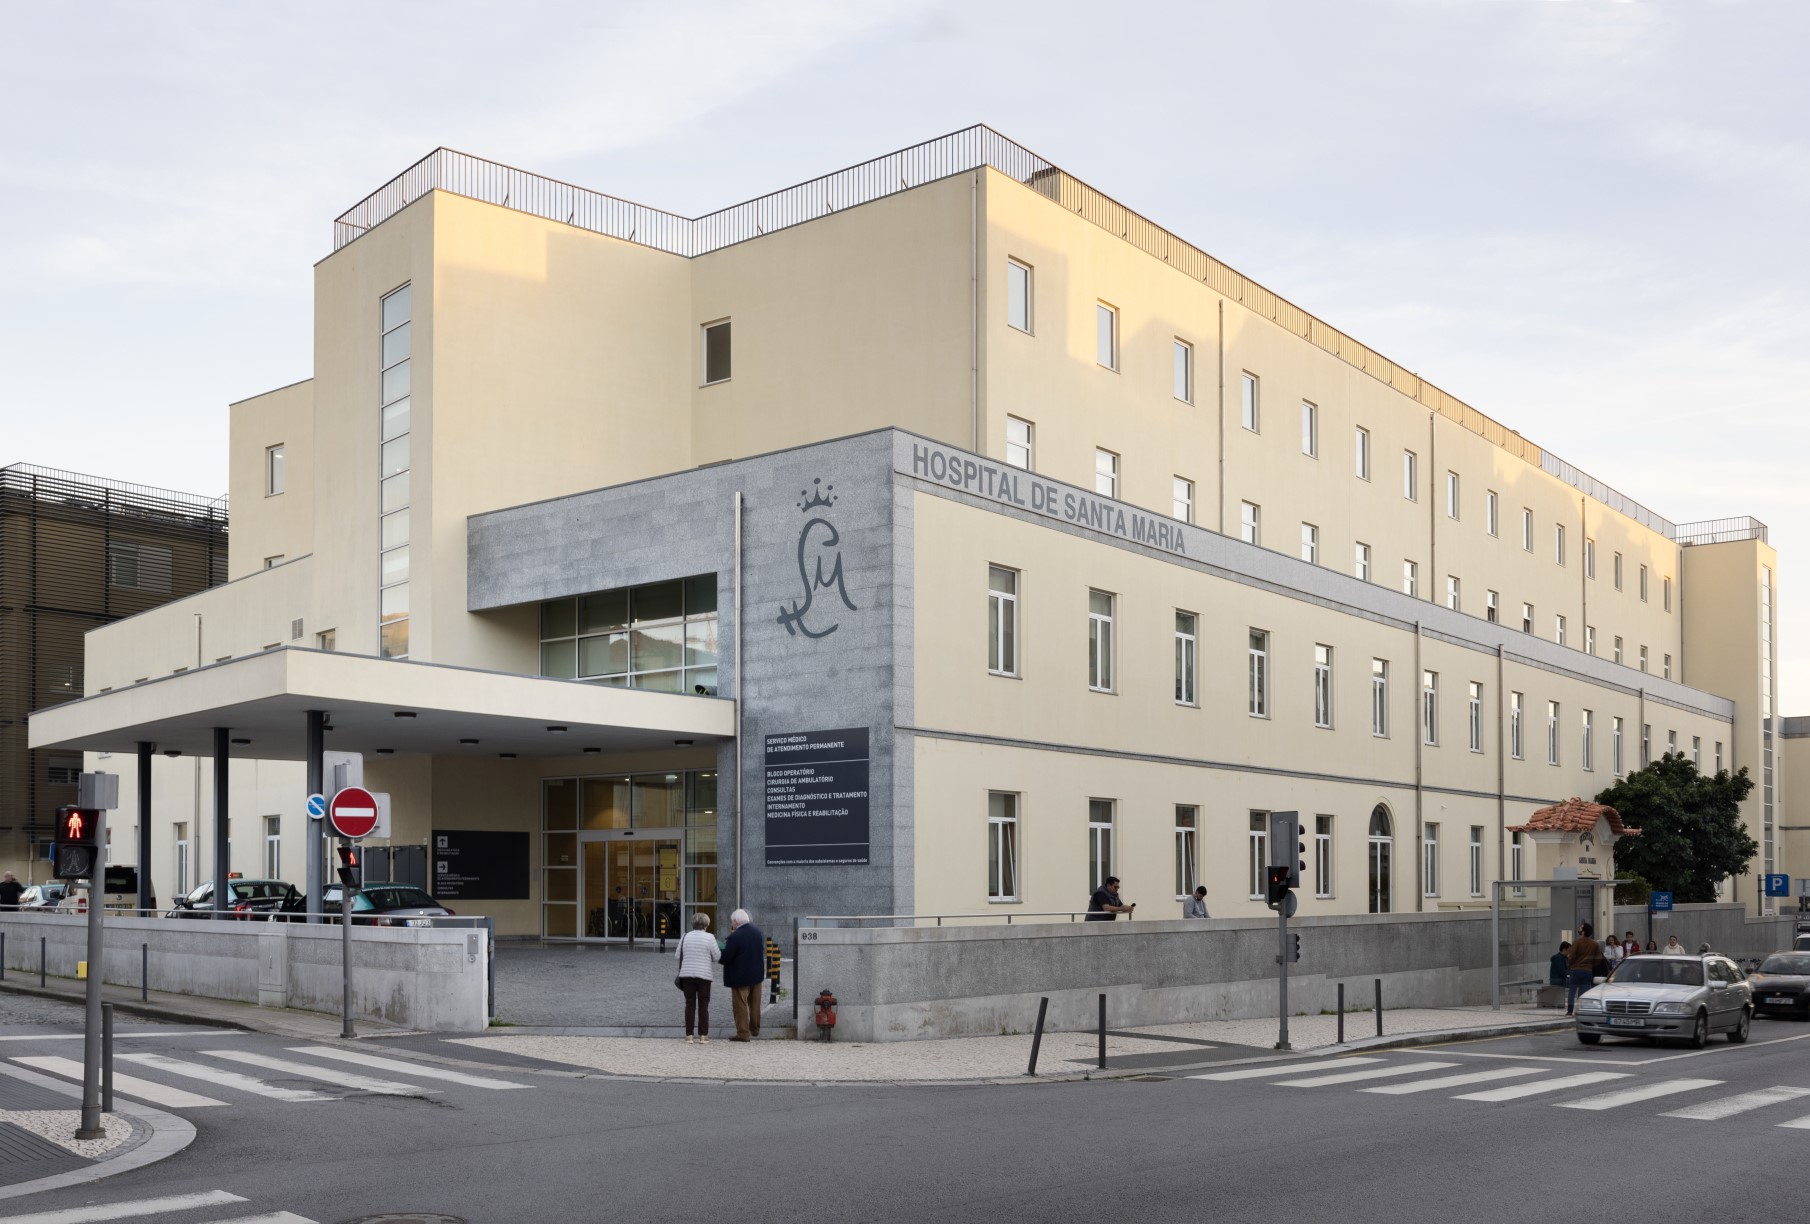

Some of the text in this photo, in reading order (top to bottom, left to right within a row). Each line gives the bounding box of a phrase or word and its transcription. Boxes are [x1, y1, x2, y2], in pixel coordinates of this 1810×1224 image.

[913, 444, 1186, 554] HOSPITAL DE SANTA MARIA
[767, 735, 807, 745] SERVIÇO MÉDICO
[774, 744, 809, 752] ATENDIMENTO
[810, 741, 845, 750] PERMANENTE
[767, 768, 815, 778] BLOCO OPERATÓRIO
[767, 778, 790, 786] CIRURGIA
[798, 775, 834, 784] AMBULATÓRIO
[767, 786, 796, 794] CONSULTAS
[795, 792, 828, 801] DIAGNÓSTICO
[833, 791, 868, 799] TRATAMENTO
[767, 802, 806, 810] INTERNAMENTO
[767, 811, 791, 819] MEDICINA
[791, 809, 808, 817] FÍSICA
[812, 807, 849, 817] REABILITAÇÃO
[1772, 877, 1783, 891] P
